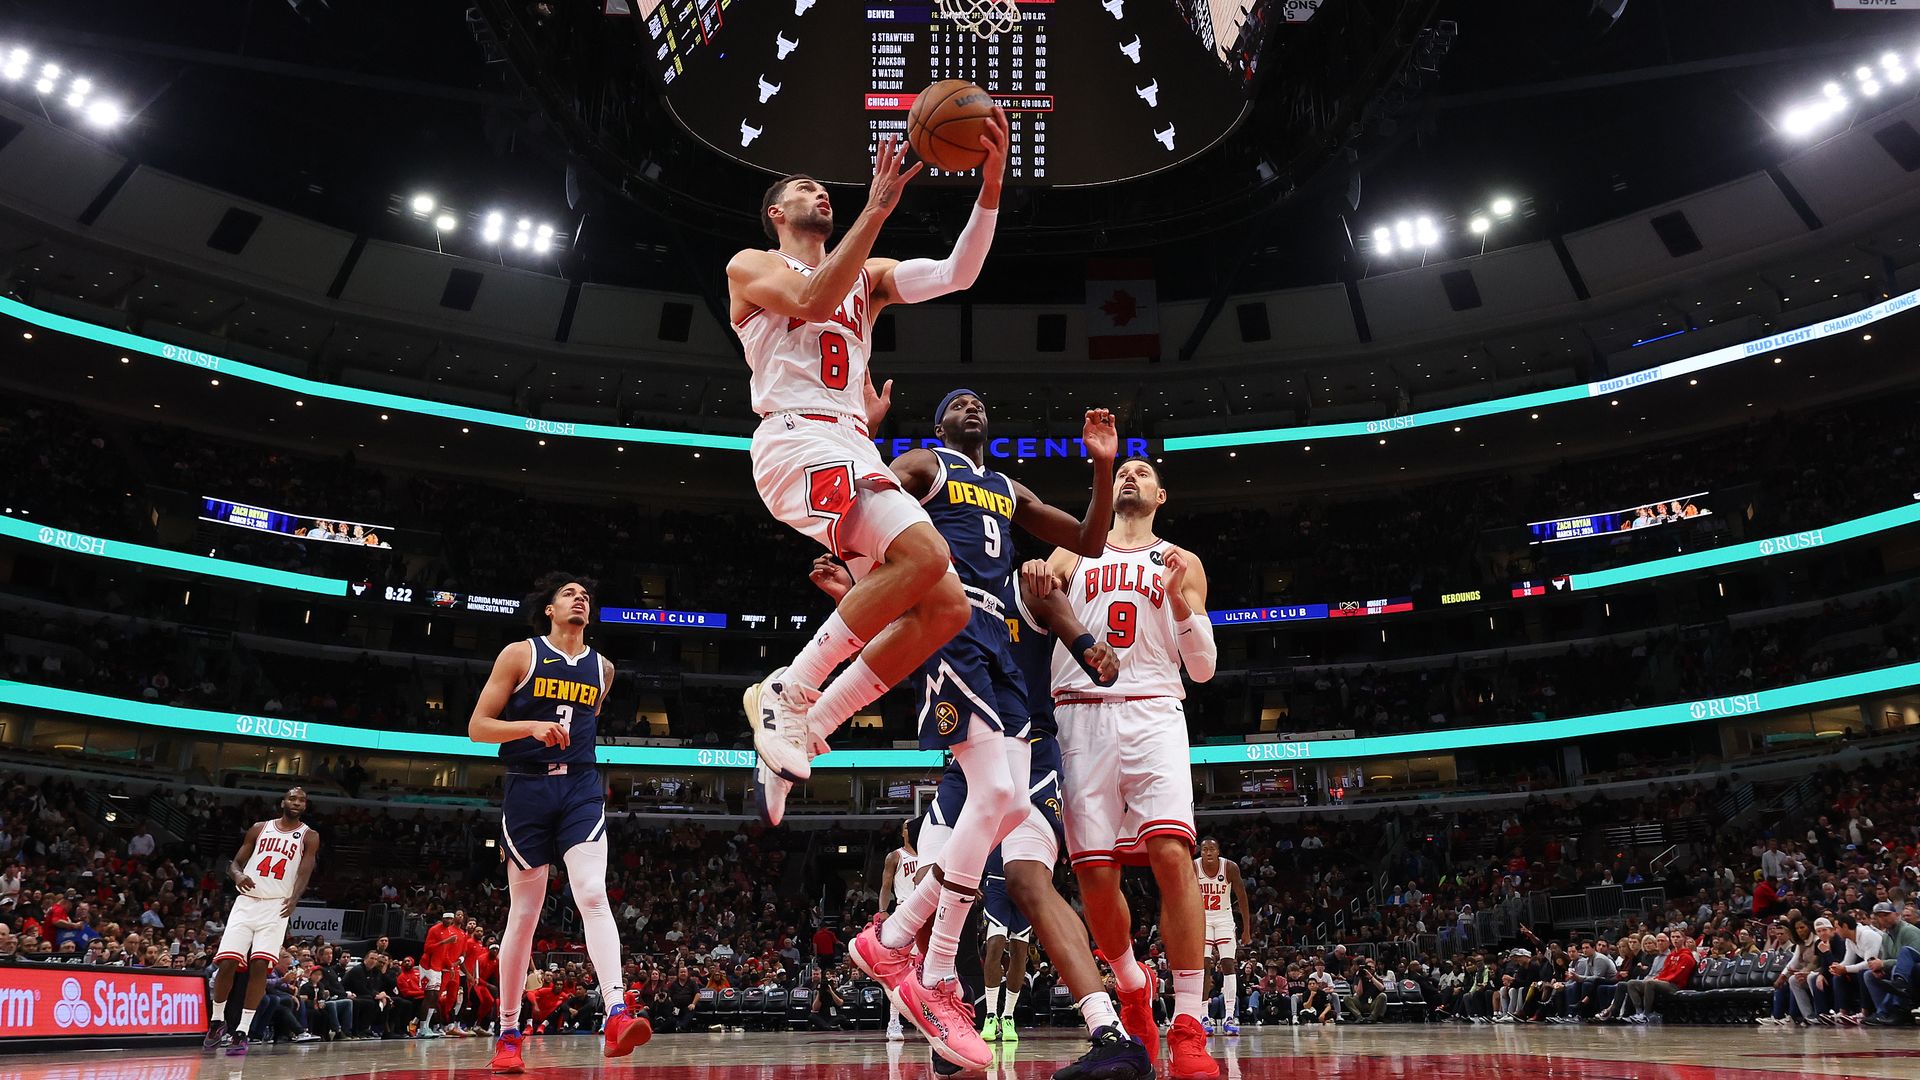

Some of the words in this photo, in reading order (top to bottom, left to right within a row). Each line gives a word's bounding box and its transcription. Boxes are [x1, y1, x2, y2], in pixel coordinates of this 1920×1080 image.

[868, 10, 894, 18] DENVER
[878, 33, 914, 42] STRAWTHER
[878, 45, 901, 53] JORDAN
[878, 57, 905, 65] JACKSON
[878, 69, 903, 77] WATSON
[878, 81, 903, 89] HOLIDAY
[868, 98, 899, 107] CHICAGO
[878, 121, 906, 129] DOSUNMU
[1823, 311, 1873, 333] CHAMPIONS
[1884, 294, 1917, 314] LOUNGE
[1747, 340, 1773, 353] BUD
[1775, 329, 1812, 347] LIGHT
[177, 347, 219, 369] RUSH
[818, 330, 849, 391] 8
[1600, 379, 1623, 392] BUD
[1625, 370, 1658, 386] LIGHT
[539, 420, 575, 435] RUSH
[1380, 416, 1415, 431] RUSH
[989, 438, 1148, 458] CENTR
[947, 480, 1013, 519] DENVER
[232, 505, 248, 517] ZACH
[1556, 521, 1572, 531] ZACH
[54, 529, 106, 555] RUSH
[983, 515, 1001, 558] 9
[1775, 529, 1824, 552] RUSH
[1085, 562, 1164, 609] BULLS
[385, 586, 413, 603] 8:22
[467, 595, 491, 605] FLORIDA
[491, 597, 521, 608] PANTHERS
[1441, 591, 1481, 605] REBOUNDS
[466, 602, 499, 613] MINNESOTA
[499, 605, 514, 614] WILD
[1225, 611, 1258, 621] ULTRA
[1270, 608, 1307, 619] CLUB
[622, 611, 656, 621] ULTRA
[668, 613, 705, 624] CLUB
[1107, 600, 1138, 648] 9
[533, 677, 598, 707] DENVER
[1708, 693, 1760, 717] RUSH
[254, 718, 308, 739] RUSH
[1263, 742, 1311, 759] RUSH
[257, 838, 298, 861] BULLS
[256, 856, 287, 880] 44
[1203, 895, 1221, 910] 12
